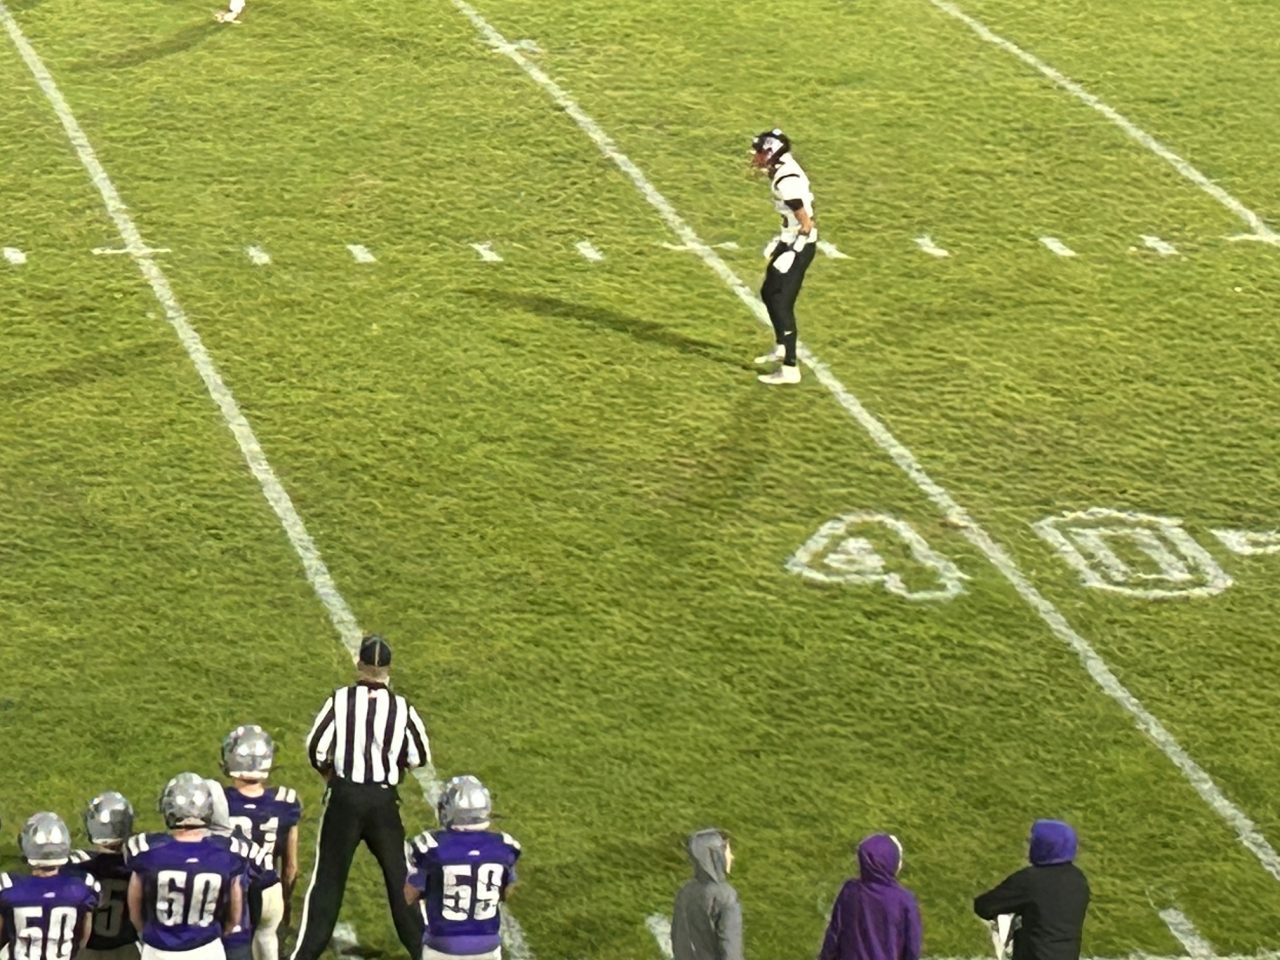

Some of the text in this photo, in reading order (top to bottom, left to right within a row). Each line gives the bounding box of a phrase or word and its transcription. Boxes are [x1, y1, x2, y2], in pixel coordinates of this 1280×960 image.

[156, 869, 223, 928] 60
[441, 863, 504, 921] 59
[13, 906, 78, 960] 50
